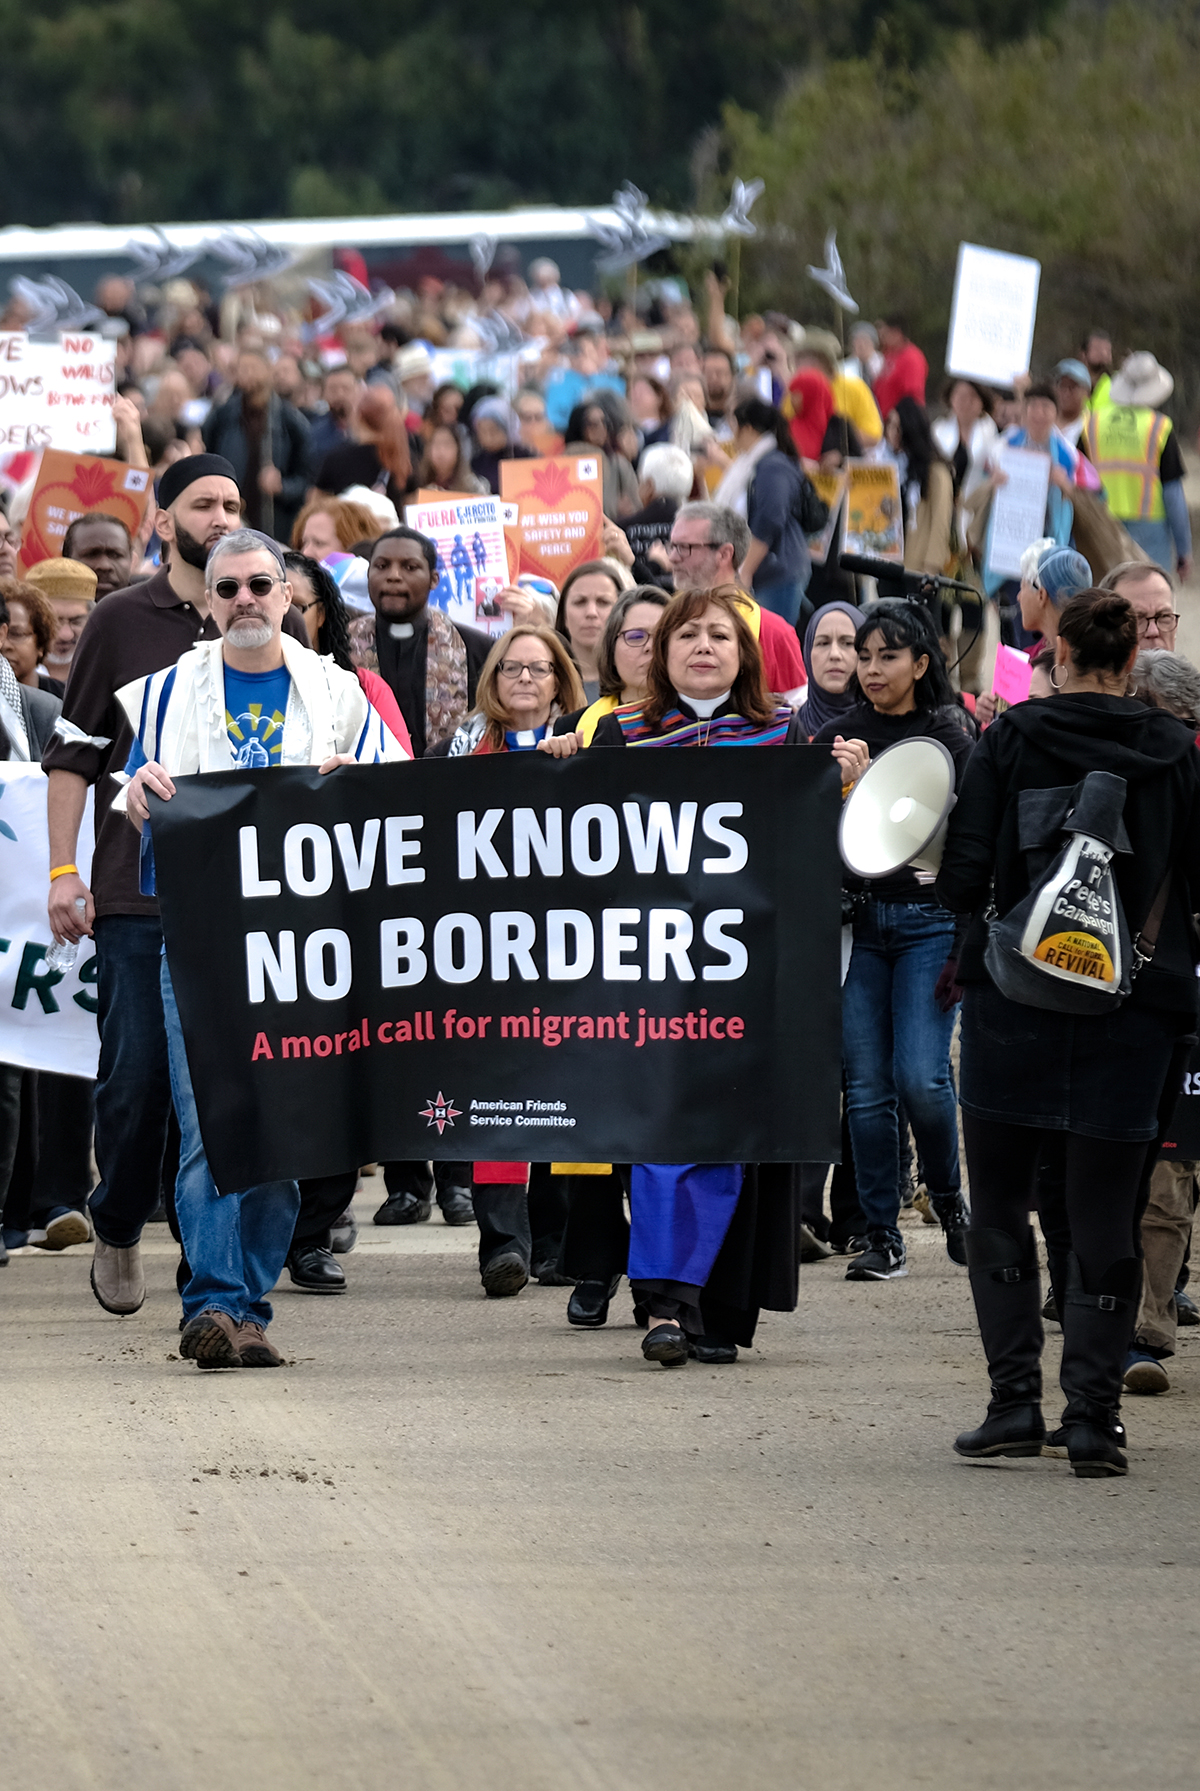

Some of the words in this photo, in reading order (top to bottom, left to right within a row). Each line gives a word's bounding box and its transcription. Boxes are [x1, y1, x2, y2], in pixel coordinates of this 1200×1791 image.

[61, 337, 94, 354] NO
[47, 505, 66, 520] WE
[521, 515, 536, 527] WE
[538, 513, 567, 526] WISH
[568, 511, 589, 523] YOU
[524, 528, 563, 542] SAFETY
[564, 527, 586, 539] AND
[540, 543, 572, 556] PEACE
[239, 814, 427, 897] LOVE
[456, 801, 750, 881] KNOWS
[1057, 942, 1074, 953] CALL
[245, 928, 353, 1003] NO
[380, 908, 750, 989] BORDERS
[1044, 948, 1106, 981] REVIVAL
[251, 1031, 275, 1062] A
[281, 1018, 371, 1061] moral
[377, 1011, 436, 1044] call
[442, 1008, 492, 1040] for
[500, 1006, 630, 1047] migrant
[634, 1007, 746, 1048] justice
[469, 1099, 524, 1111] American
[526, 1100, 567, 1111] Friends
[470, 1114, 513, 1127] Service
[515, 1115, 577, 1127] Committee
